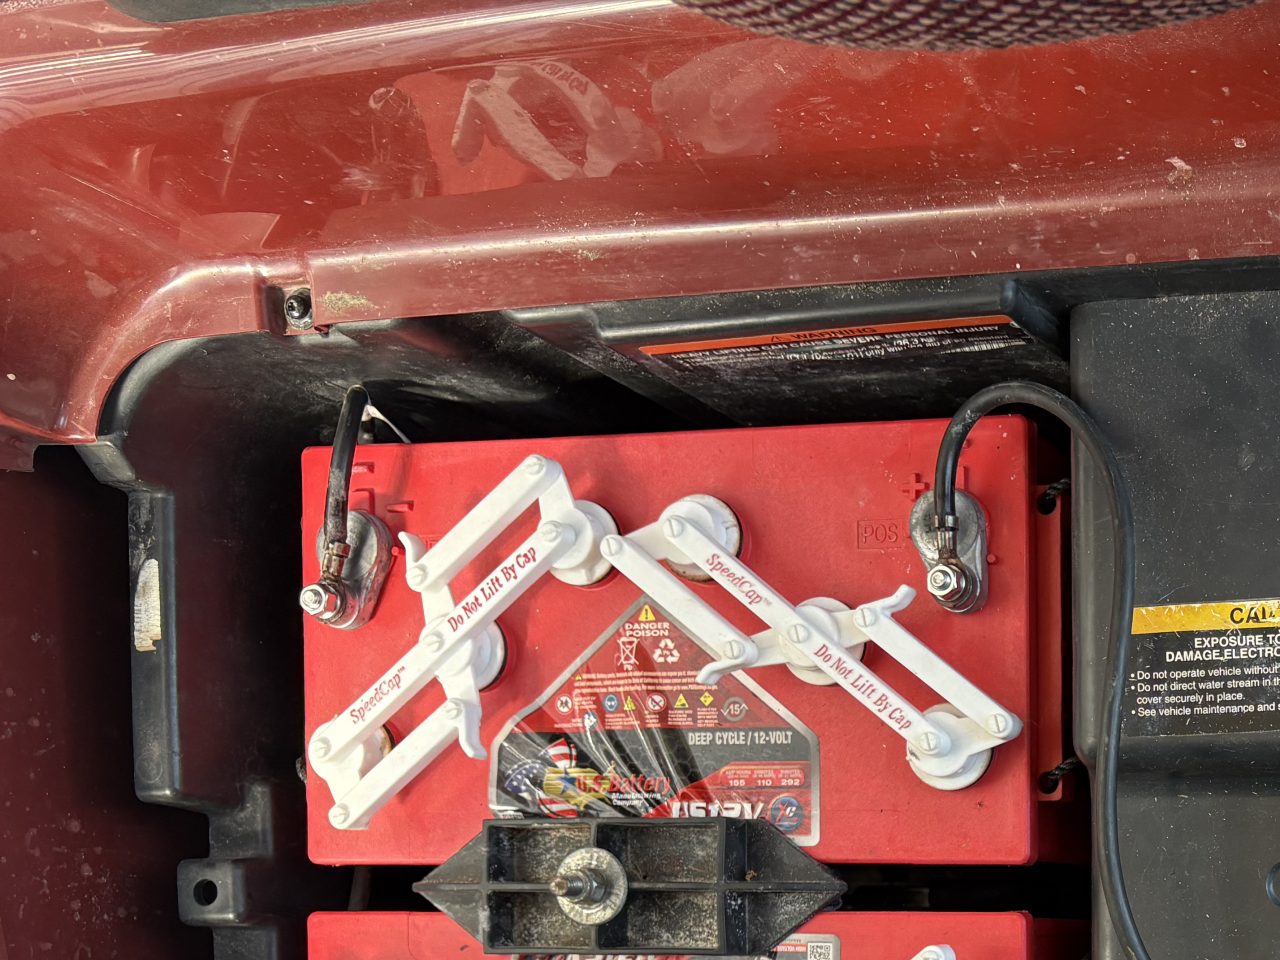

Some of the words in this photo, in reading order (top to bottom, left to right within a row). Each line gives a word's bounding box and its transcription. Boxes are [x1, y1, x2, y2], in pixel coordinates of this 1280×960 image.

[792, 327, 878, 339] WARNING
[957, 325, 1000, 335] INJURY
[1194, 636, 1263, 649] EXPOSURE
[1166, 650, 1220, 662] DAMAGE
[1137, 671, 1150, 680] Do
[1170, 669, 1205, 682] operate
[1208, 667, 1241, 676] vehicle
[1244, 665, 1279, 675] without
[814, 644, 833, 663] Do
[832, 657, 854, 678] Not
[851, 675, 875, 700] Lift
[872, 695, 890, 718] By
[888, 707, 911, 730] Cap
[1138, 683, 1150, 692] Do
[1170, 680, 1196, 691] direct
[1200, 679, 1223, 689] water
[1227, 677, 1260, 688] stream
[1263, 677, 1271, 686] in
[1137, 696, 1162, 705] cover
[1165, 692, 1203, 705] securely
[1206, 692, 1214, 702] in
[1217, 690, 1245, 703] place.
[1138, 708, 1156, 716] See
[1159, 706, 1191, 716] vehicle
[1194, 703, 1254, 715] maintenance
[1257, 702, 1275, 711] and
[688, 732, 712, 745] DEEP
[716, 732, 745, 745] CYCLE
[754, 732, 792, 745] 12-VOLT
